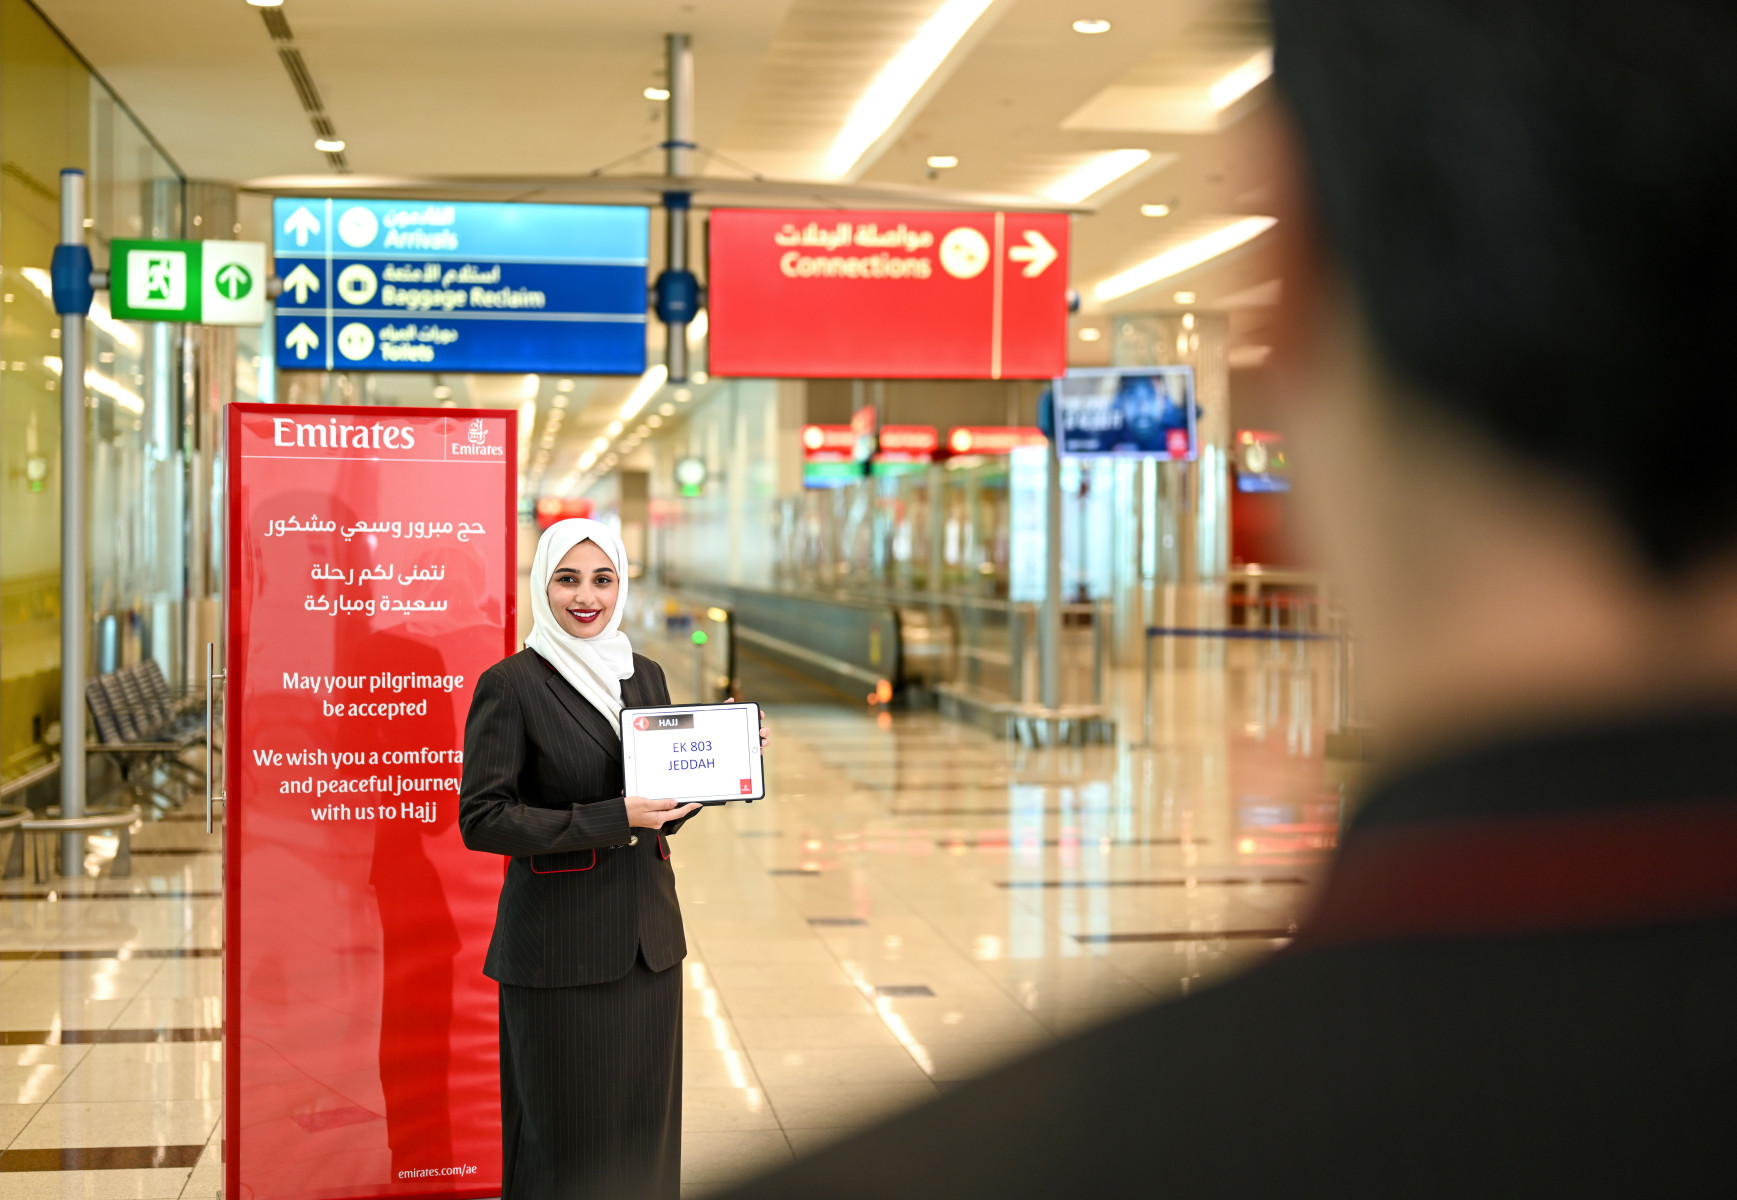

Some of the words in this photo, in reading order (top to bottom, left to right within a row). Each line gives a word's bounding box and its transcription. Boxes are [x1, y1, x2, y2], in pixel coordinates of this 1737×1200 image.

[384, 229, 458, 250] Arrivals
[774, 222, 852, 251] الرحلات
[853, 222, 934, 252] مواصلة
[780, 251, 932, 279] Connections
[442, 264, 500, 289] استلام
[382, 284, 468, 311] Baggage
[470, 286, 546, 309] Reclaim
[380, 341, 435, 362] Toilets
[273, 418, 415, 449] Emirates
[452, 443, 503, 456] Emirates
[264, 514, 336, 537] مشكور
[341, 521, 402, 542] وسعي
[404, 521, 453, 538] مبرور
[457, 522, 485, 541] حج
[311, 564, 353, 585] رحلة
[358, 564, 394, 586] لكم
[398, 564, 445, 585] نتمنى
[304, 595, 375, 616] ومباركة
[380, 595, 447, 615] سعيدة
[283, 672, 321, 693] May
[324, 675, 366, 693] your
[370, 672, 464, 693] pilgrimage
[323, 700, 344, 716] be
[348, 699, 427, 720] accepted
[658, 718, 679, 727] HAJJ
[673, 742, 687, 753] EK
[690, 740, 713, 752] 803
[253, 749, 282, 766] We
[286, 749, 328, 765] wish
[331, 751, 365, 769] you
[369, 751, 379, 765] a
[382, 747, 463, 764] comforta
[668, 758, 715, 771] JEDDAH
[280, 777, 312, 794] and
[317, 776, 393, 797] peaceful
[394, 775, 462, 796] journey
[311, 804, 351, 820] with
[355, 806, 375, 820] us
[379, 805, 397, 819] to
[401, 802, 437, 823] Hajj
[398, 1163, 477, 1179] emirates.com/ae
